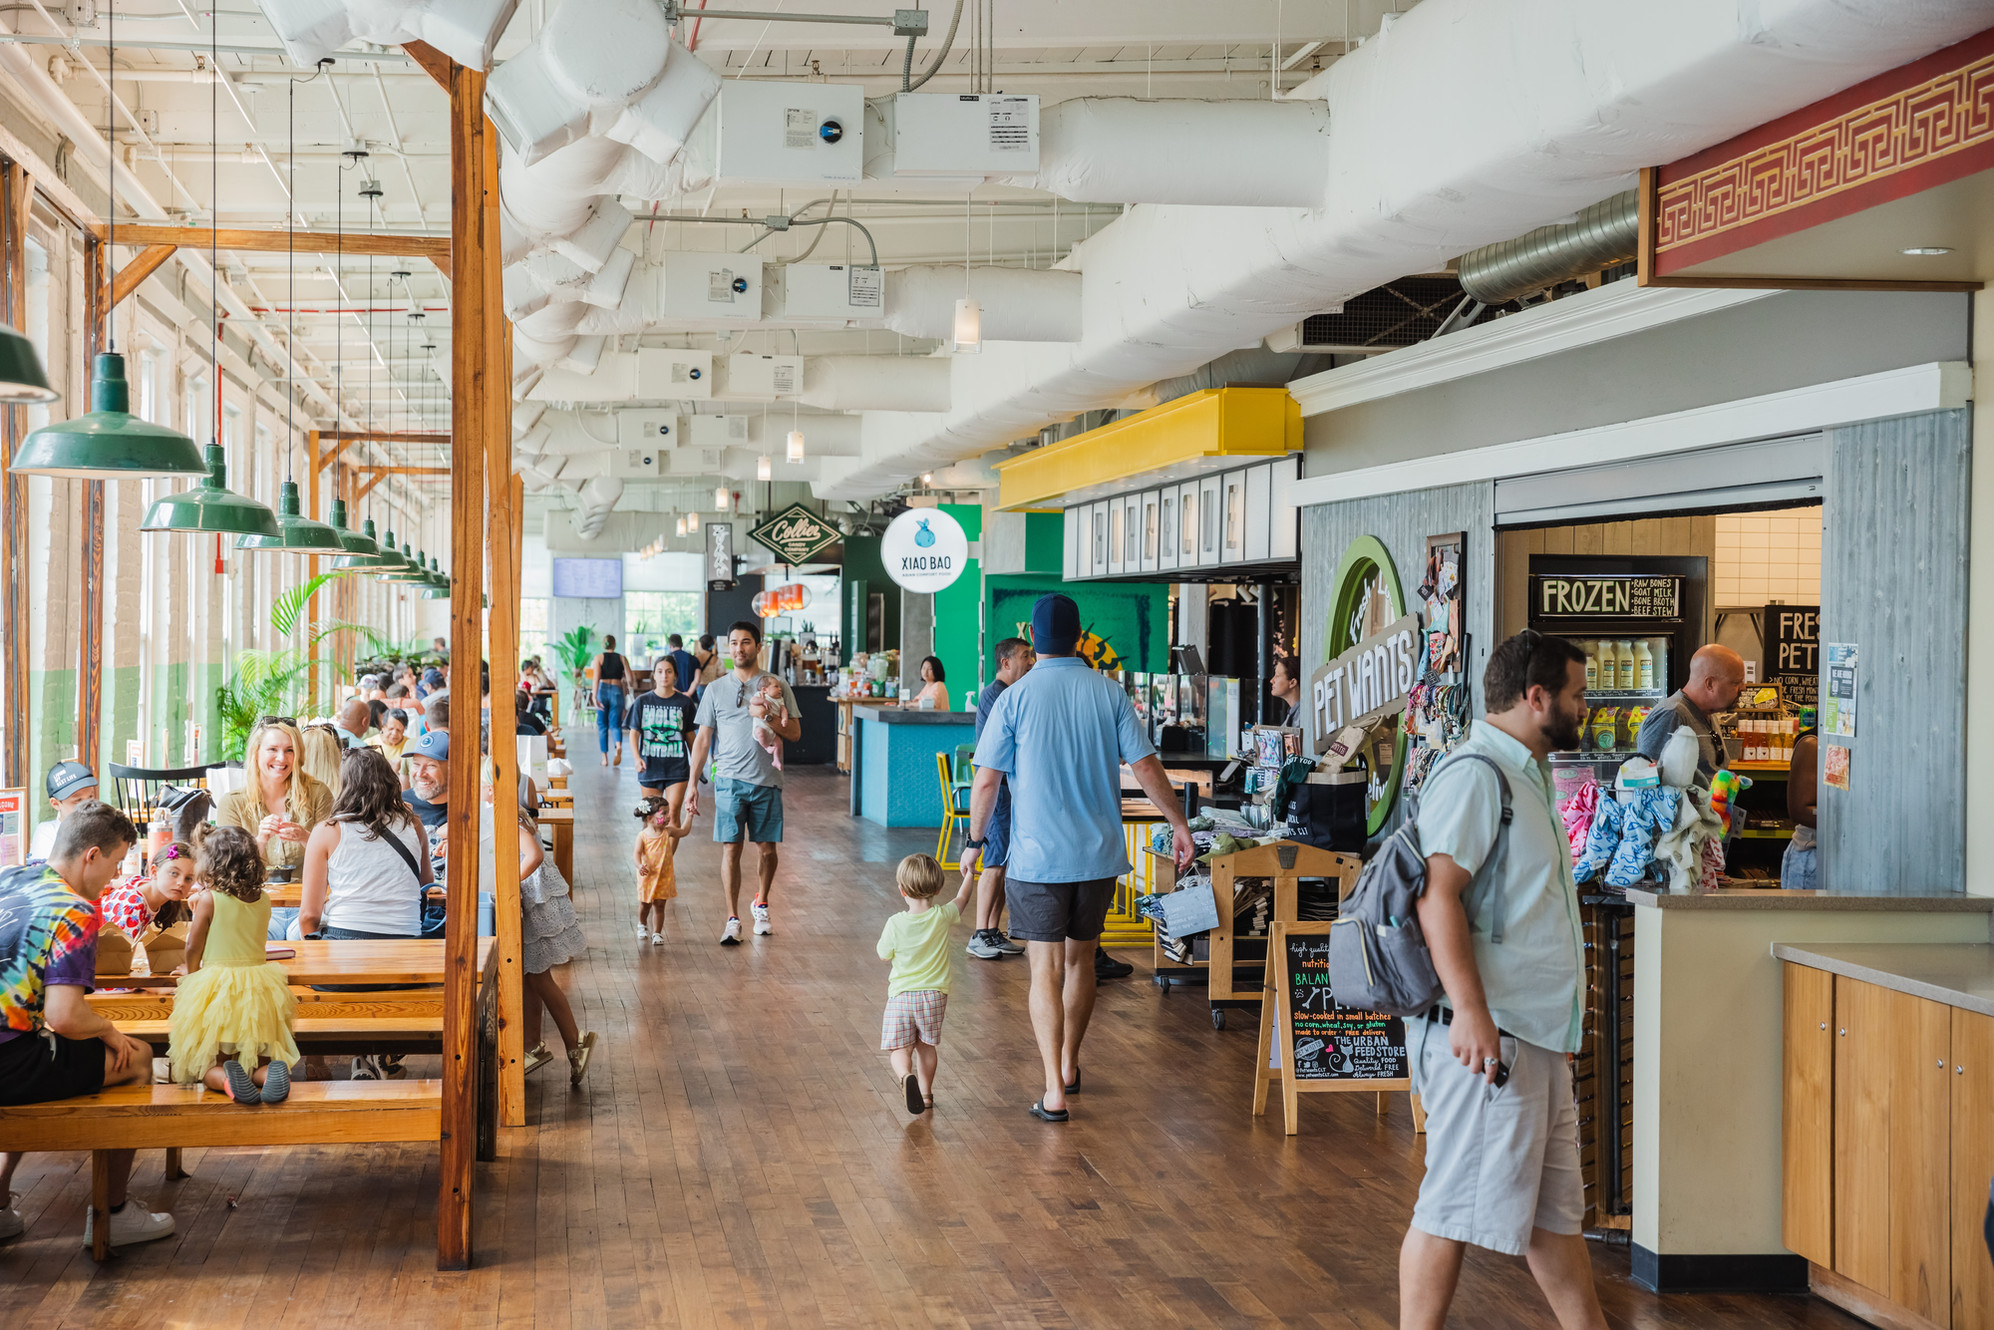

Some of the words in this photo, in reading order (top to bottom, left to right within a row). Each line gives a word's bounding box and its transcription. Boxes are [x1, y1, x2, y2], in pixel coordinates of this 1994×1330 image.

[772, 518, 821, 543] Collier
[902, 556, 927, 570] XIAO
[930, 556, 951, 570] BAO
[1633, 579, 1649, 588] RAW
[1650, 578, 1672, 588] BONES
[1543, 580, 1631, 612] FROZEN
[1633, 587, 1651, 596] GOAT
[1653, 588, 1673, 598] MILK
[1633, 597, 1651, 605] BONE
[1653, 597, 1675, 607] BROTH
[1633, 606, 1651, 615] BEEF
[1652, 606, 1674, 616] STEW
[1779, 642, 1818, 670] PET
[1313, 666, 1345, 741] PET
[1347, 629, 1414, 720] WANTS
[641, 708, 684, 731] EAGLES
[1299, 757, 1313, 765] YOU
[1289, 941, 1308, 958] high
[1309, 942, 1330, 958] qualit
[1301, 958, 1330, 968] nutritio
[1295, 973, 1329, 985] BALAN
[1293, 1010, 1335, 1020] slow-cooked
[1336, 1010, 1344, 1020] in
[1345, 1011, 1363, 1020] small
[1365, 1011, 1391, 1021] batches
[1365, 1021, 1386, 1030] gluten
[1362, 1029, 1386, 1038] delivery
[1334, 1036, 1352, 1045] THE
[1352, 1036, 1389, 1047] URBAN
[1355, 1046, 1376, 1057] FEED
[1376, 1046, 1406, 1057] STORE
[1384, 1063, 1400, 1071] FREE
[1377, 1070, 1394, 1078] FRESH
